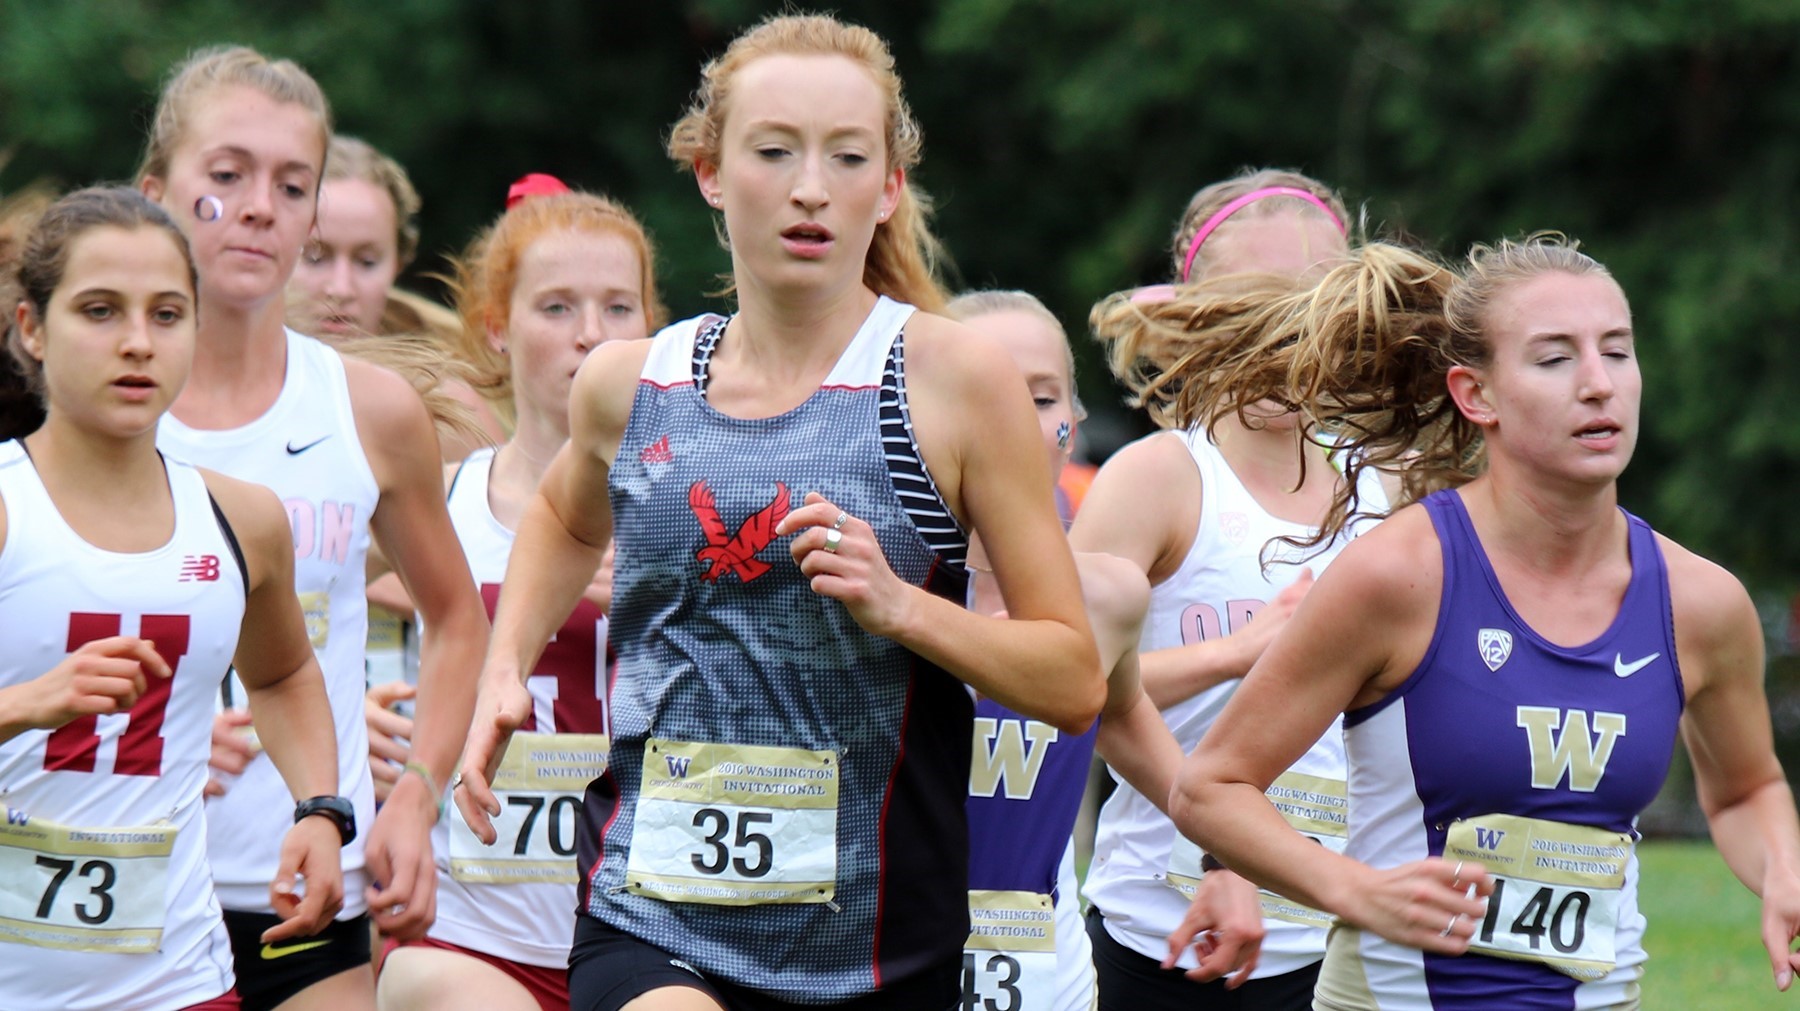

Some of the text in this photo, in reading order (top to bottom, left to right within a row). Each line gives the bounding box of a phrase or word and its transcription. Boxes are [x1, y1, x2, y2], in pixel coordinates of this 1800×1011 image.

[1481, 630, 1512, 656] PAC
[1486, 647, 1503, 664] 12
[43, 612, 191, 777] H
[530, 751, 556, 762] 2016
[968, 717, 1058, 800] W
[1516, 705, 1626, 793] W
[665, 756, 691, 779] W
[718, 762, 834, 780] 2016 WASHINGTON
[723, 780, 826, 795] INVITATIONAL
[1266, 786, 1291, 798] 2016
[7, 808, 31, 827] W
[1273, 802, 1347, 824] NVITATIONAL
[508, 796, 584, 856] 70
[69, 831, 166, 844] INVITATIONAL
[691, 808, 773, 878] 35
[1476, 827, 1505, 850] W
[1532, 839, 1626, 859] 2016 WASHINGTON
[1535, 856, 1620, 875] INVITATIONAL
[35, 855, 116, 925] 73
[973, 909, 1052, 922] WASHINGTON
[1481, 878, 1590, 953] 140
